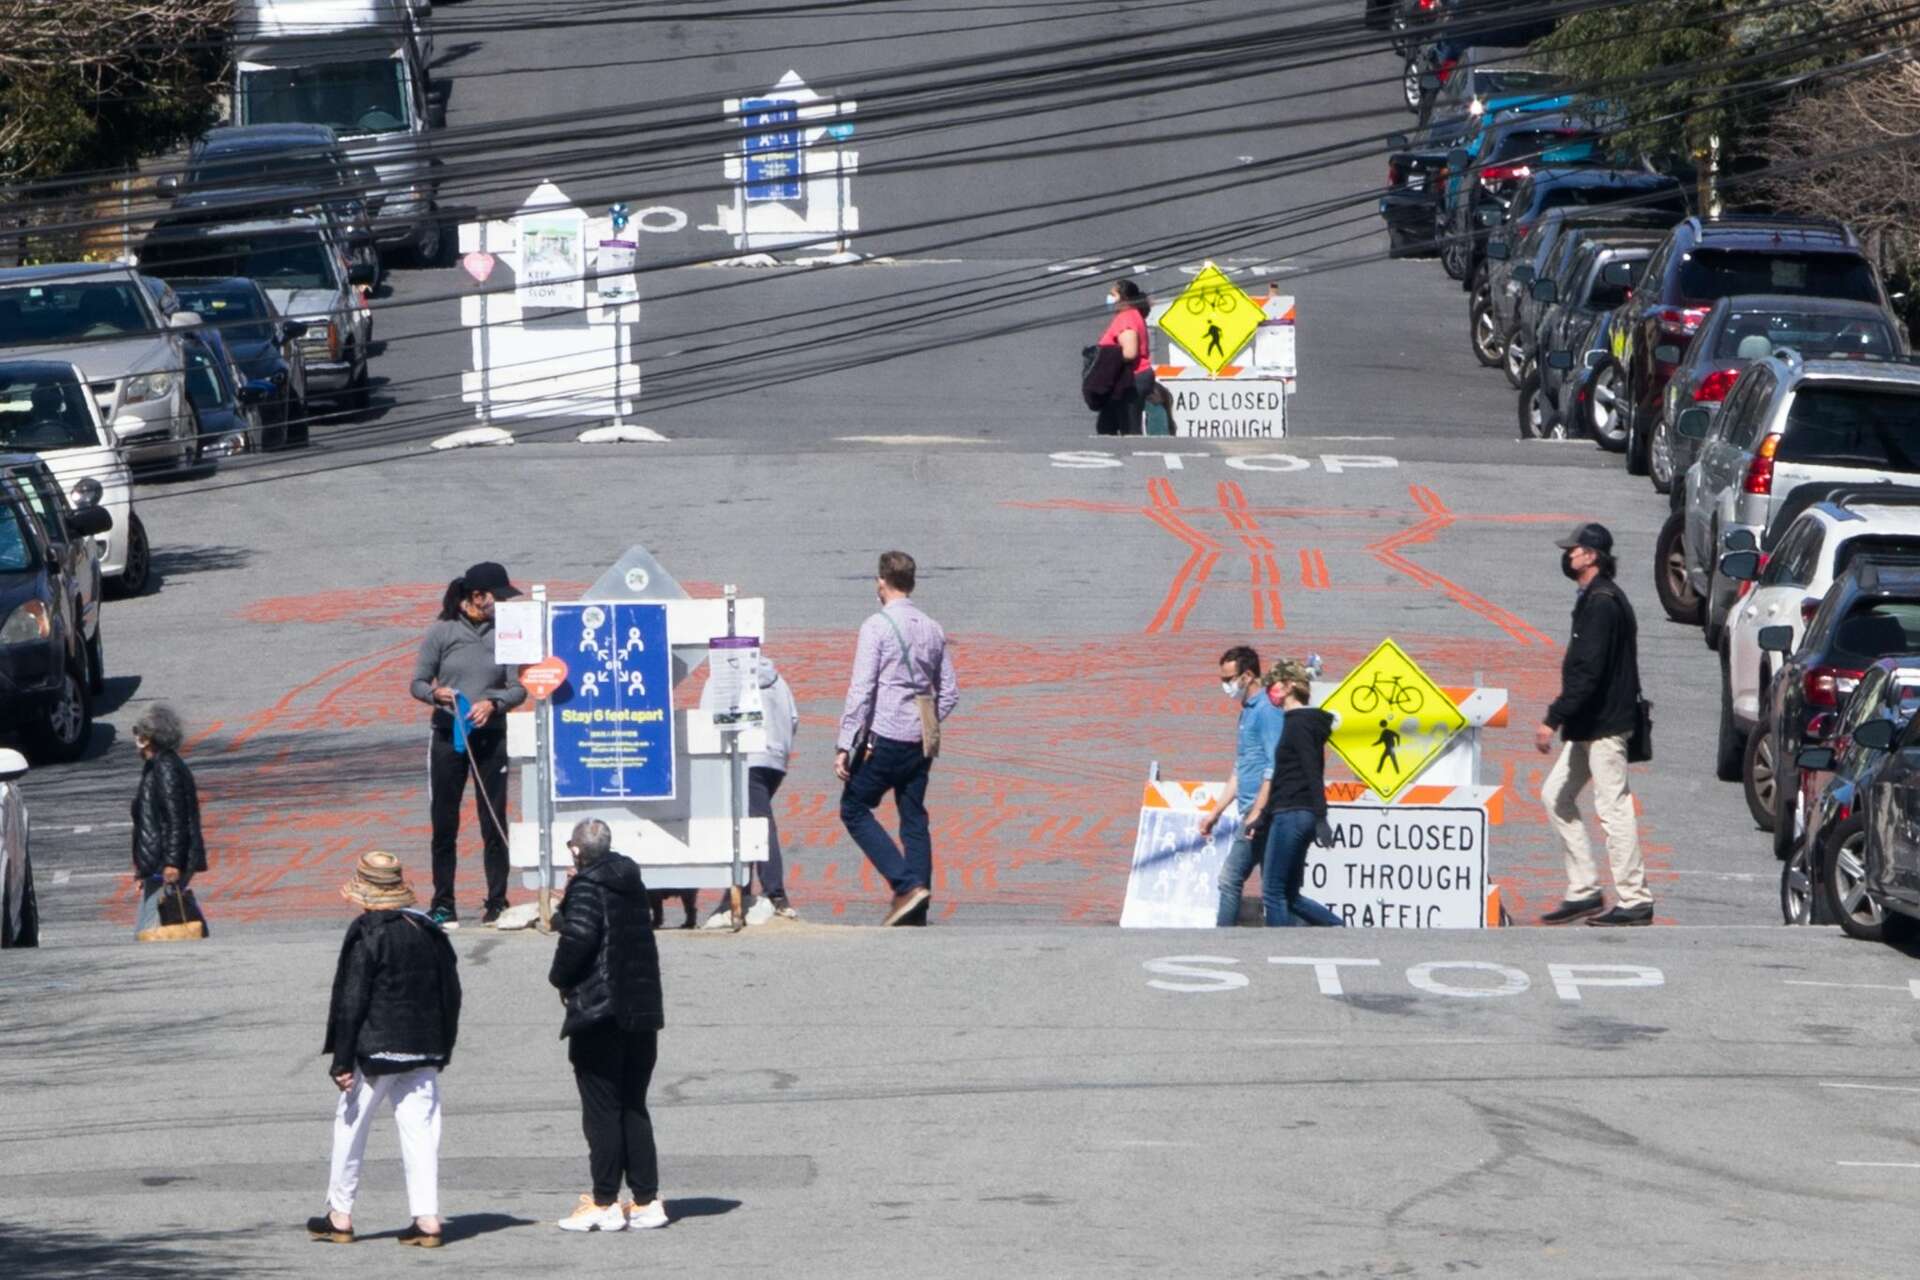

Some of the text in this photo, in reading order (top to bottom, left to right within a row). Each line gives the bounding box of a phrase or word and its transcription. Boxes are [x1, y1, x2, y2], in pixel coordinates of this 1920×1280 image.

[1208, 392, 1279, 411] CLOSED
[1186, 419, 1272, 438] THROUGH
[1049, 451, 1399, 474] STOP
[562, 709, 591, 724] Stay
[594, 709, 604, 721] 6
[631, 708, 664, 724] apart
[1377, 824, 1474, 851] CLOSED
[1345, 863, 1471, 891] THROUGH
[1325, 903, 1442, 928] TRAFFIC
[1142, 954, 1665, 1001] STOP
